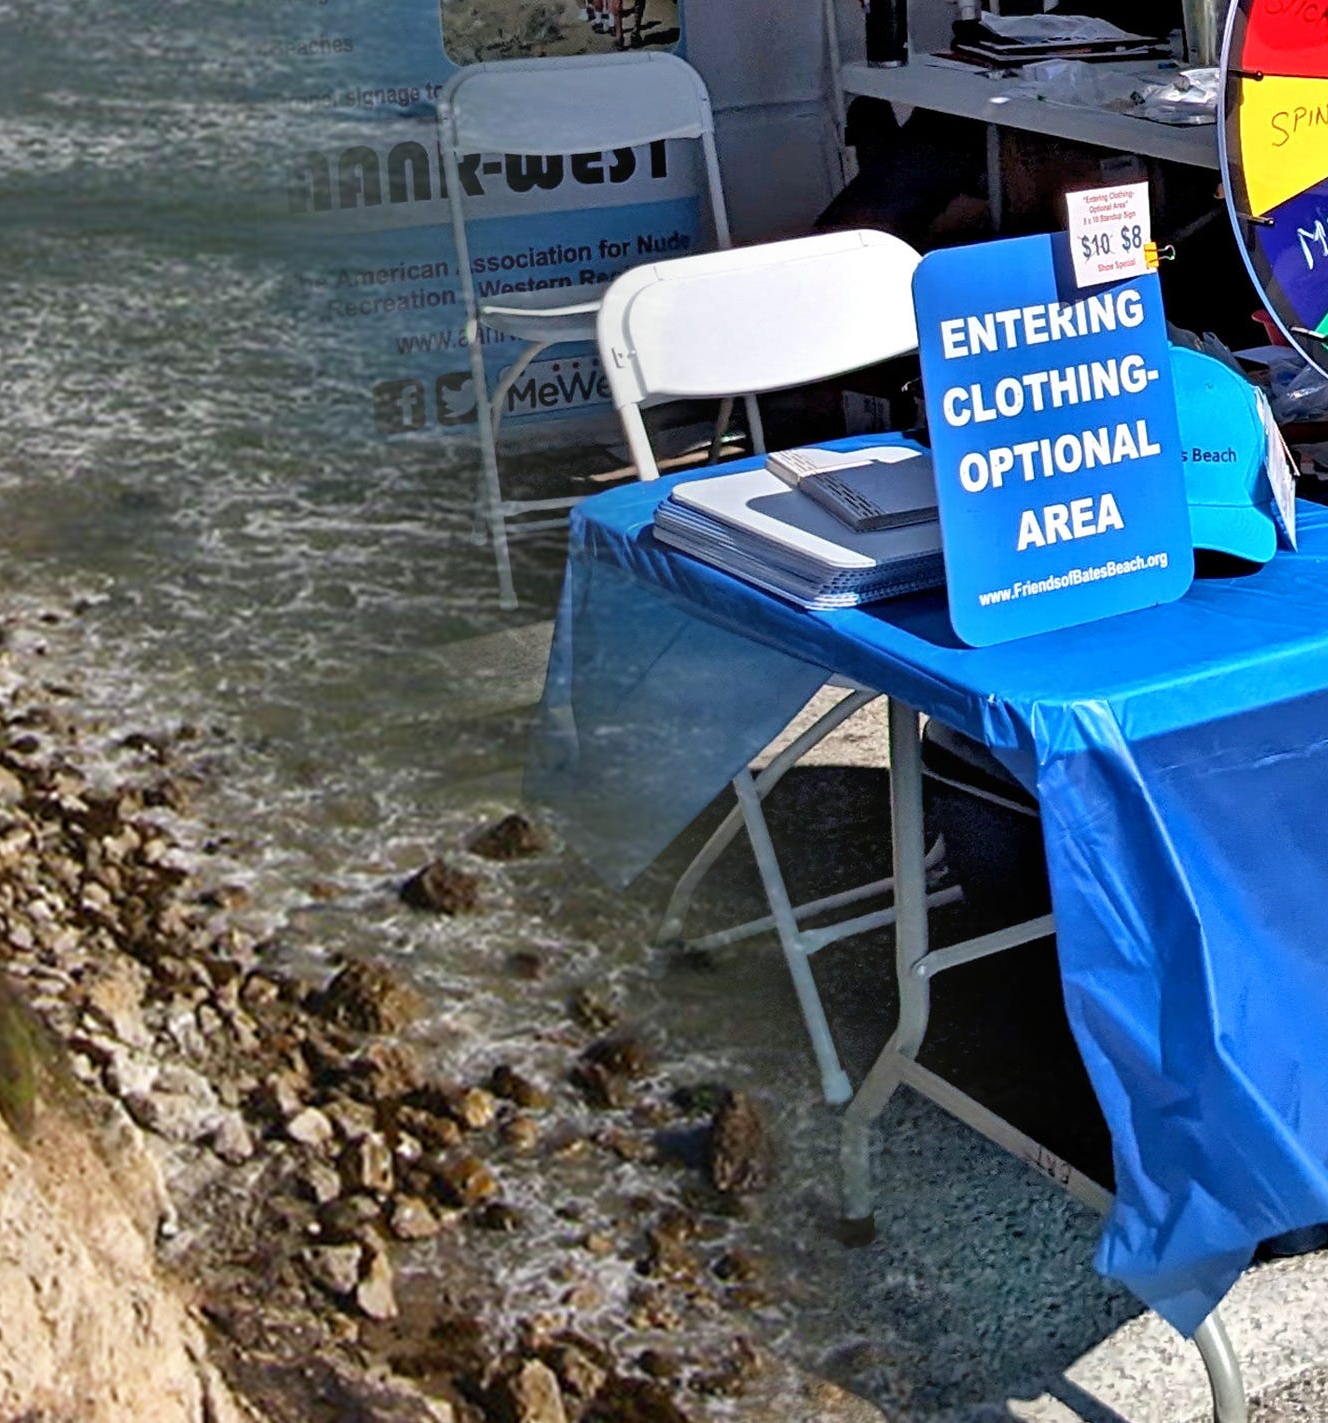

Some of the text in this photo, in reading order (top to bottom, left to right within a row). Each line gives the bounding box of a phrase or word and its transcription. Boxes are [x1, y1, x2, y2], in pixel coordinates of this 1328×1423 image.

[336, 261, 449, 288] American
[456, 245, 592, 274] ssociation
[599, 239, 631, 261] for
[637, 230, 690, 256] Nude
[1081, 224, 1143, 259] $10 $8
[327, 285, 456, 321] Recreation
[940, 288, 1144, 360] ENTERING
[507, 369, 612, 410] MeWe
[942, 352, 1159, 427] CLOTHING-
[959, 418, 1161, 493] OPTIONAL
[1192, 447, 1237, 463] Beach
[1016, 493, 1125, 552] AREA
[979, 550, 1168, 607] www.FriendsofBatesBeach.org
